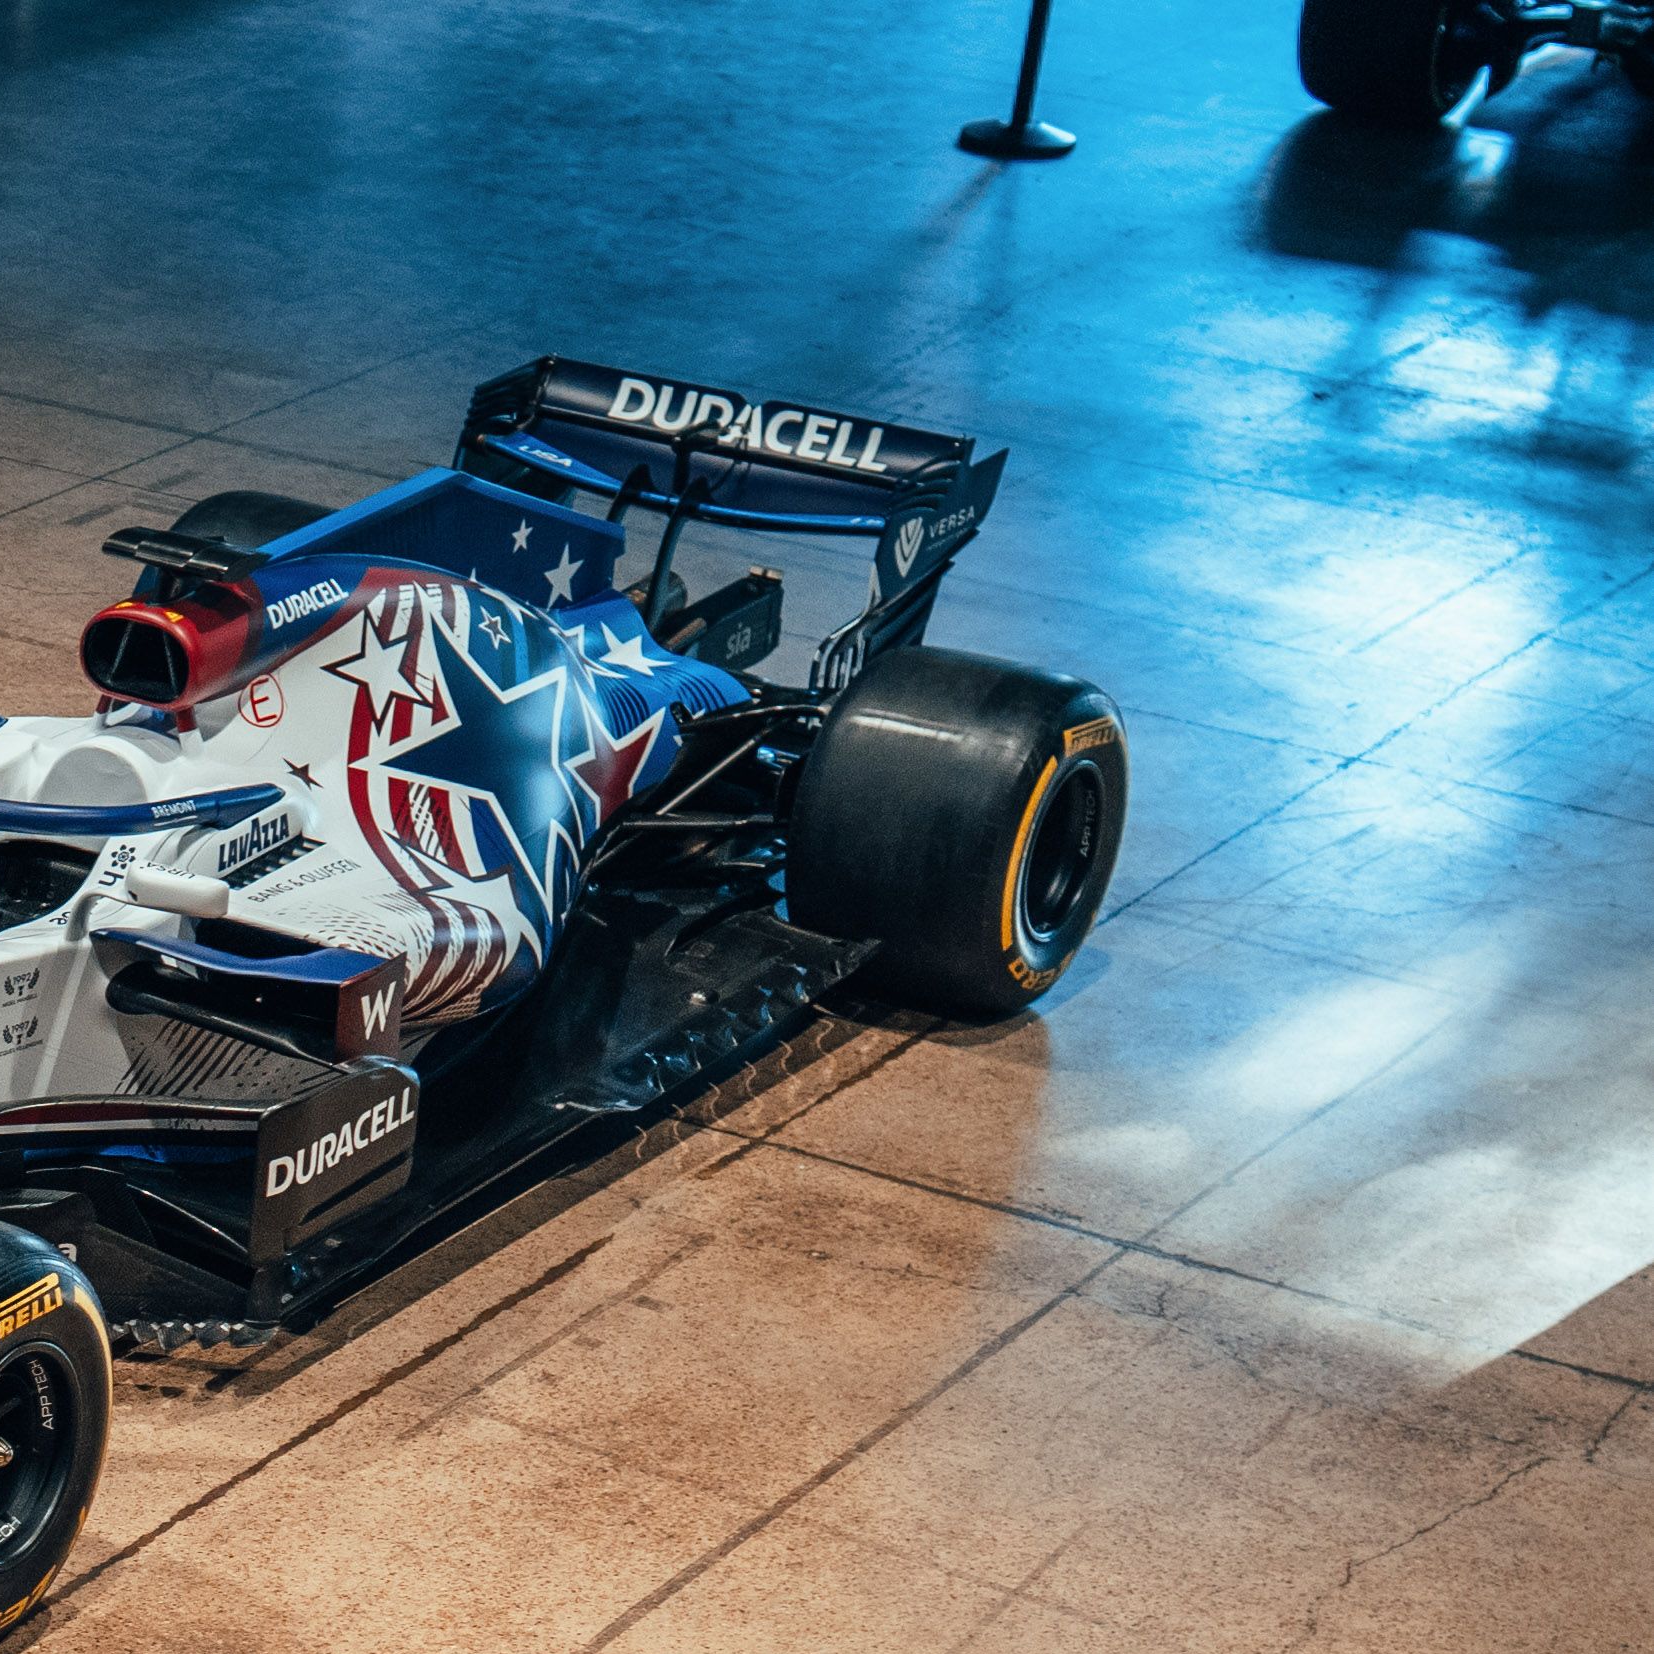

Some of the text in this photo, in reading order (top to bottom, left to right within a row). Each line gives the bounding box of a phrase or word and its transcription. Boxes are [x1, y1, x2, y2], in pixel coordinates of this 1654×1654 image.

[607, 377, 888, 473] DURACELL
[929, 505, 975, 538] VERSA
[266, 578, 349, 630] DURACELL
[151, 800, 197, 819] BREMONT
[247, 879, 293, 903] BANG
[300, 858, 362, 884] OLUFSEN
[266, 1086, 415, 1198] DURACELL
[27, 1359, 54, 1430] APP TECH
